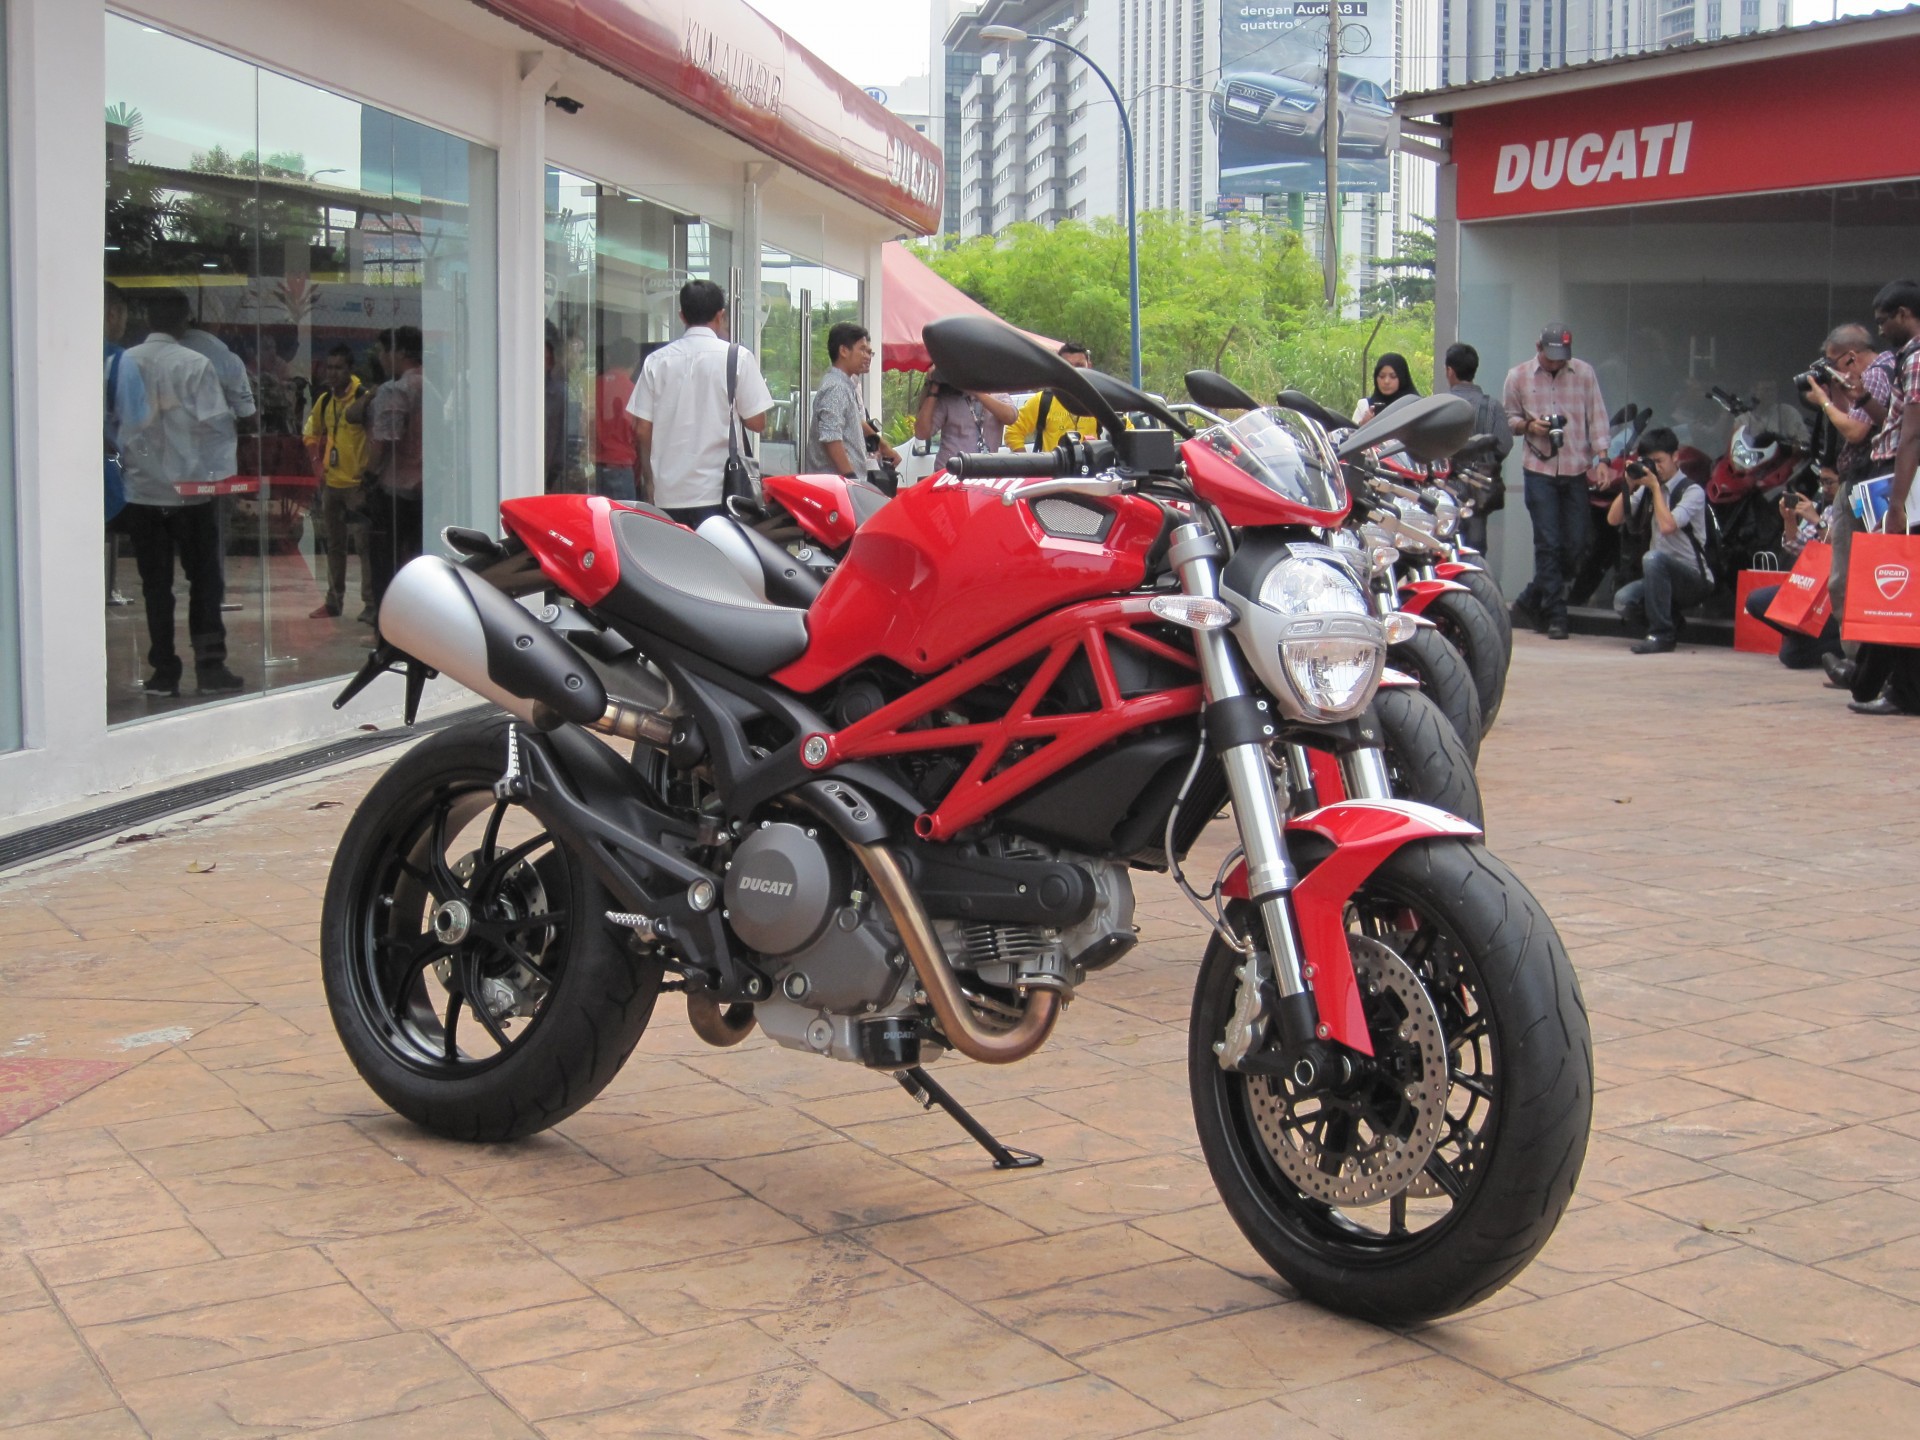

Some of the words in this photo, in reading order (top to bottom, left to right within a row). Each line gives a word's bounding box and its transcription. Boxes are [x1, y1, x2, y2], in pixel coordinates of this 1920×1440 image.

[1240, 5, 1292, 16] dengan
[1296, 4, 1329, 14] Audi
[1357, 4, 1365, 14] L
[683, 18, 729, 86] KUALA
[731, 49, 782, 117] LUMPUR
[1493, 121, 1693, 194] DUCATI
[891, 136, 939, 209] DUCATI
[1789, 573, 1816, 588] DUCATI
[1878, 569, 1906, 577] DUCATI
[739, 876, 793, 896] DUCATI
